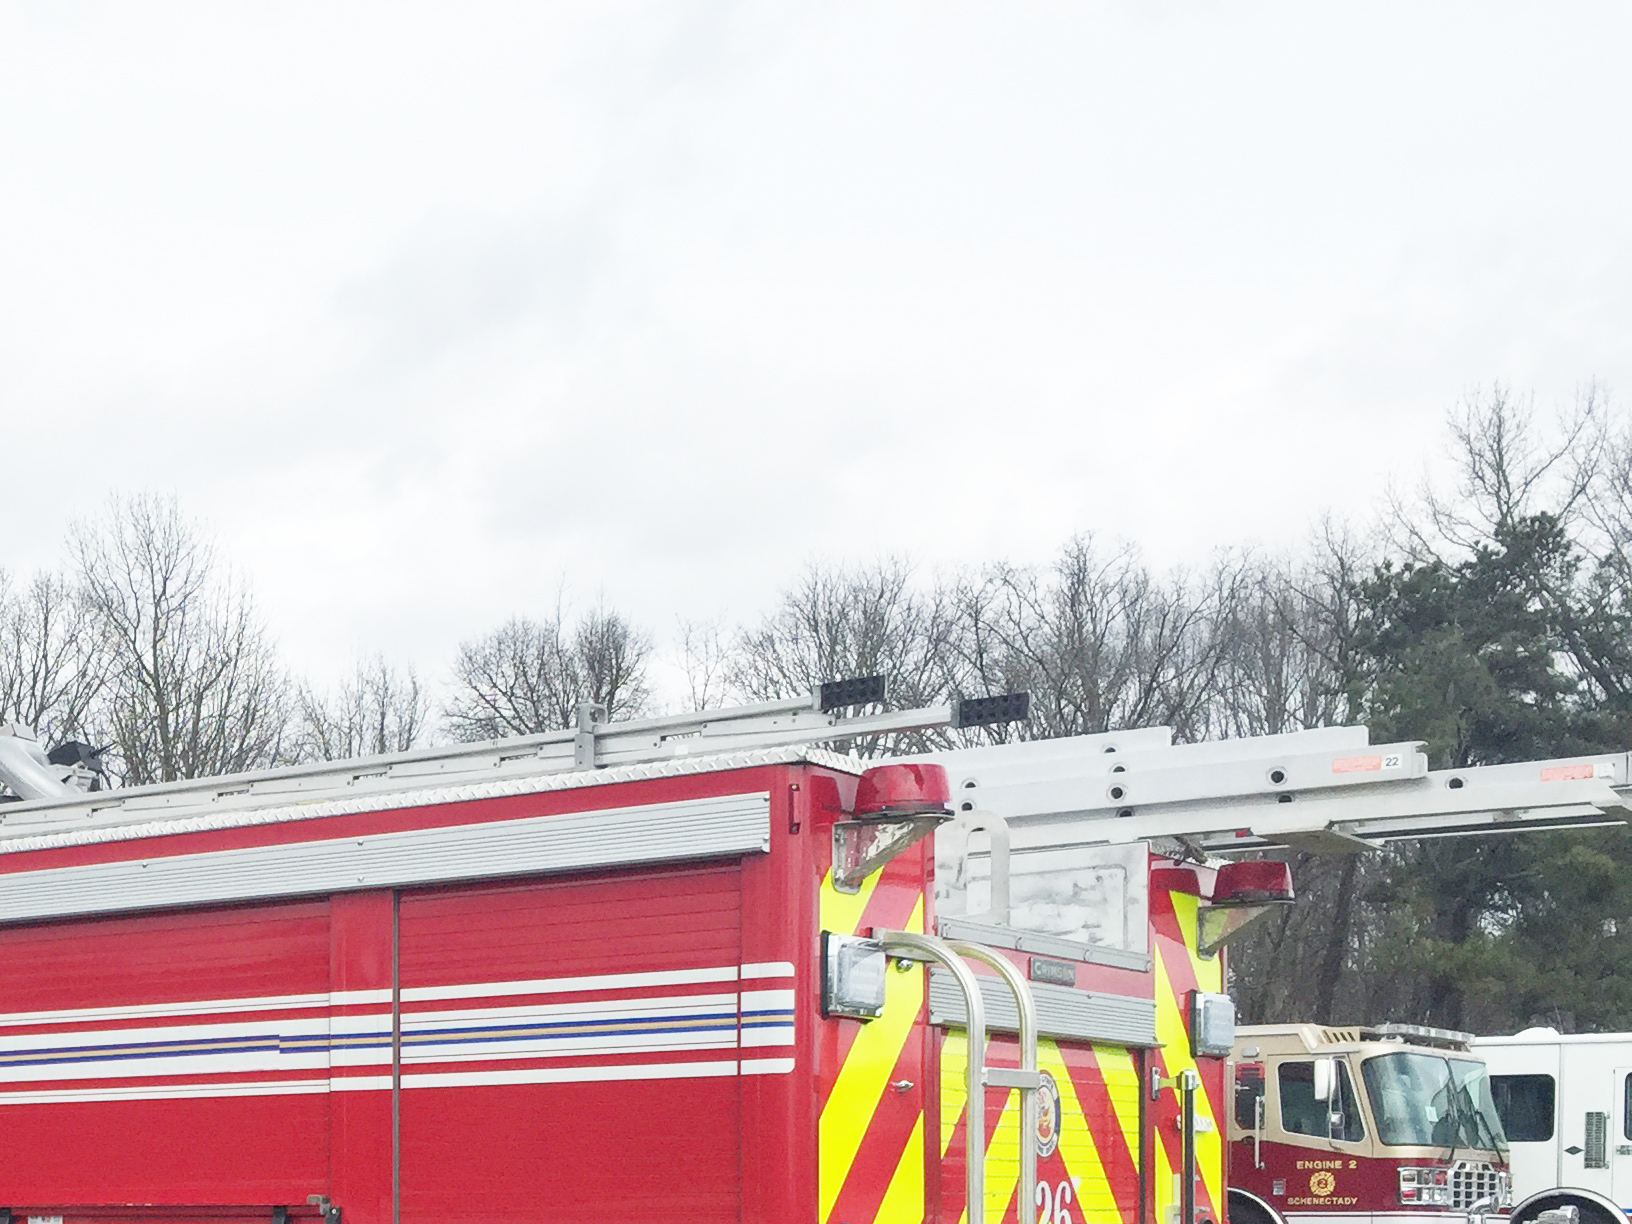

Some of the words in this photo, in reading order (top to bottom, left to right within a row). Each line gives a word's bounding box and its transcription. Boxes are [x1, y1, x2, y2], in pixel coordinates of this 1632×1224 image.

[1385, 756, 1399, 767] 22
[1296, 1160, 1343, 1170] ENGINE
[1348, 1160, 1358, 1169] 2
[1287, 1197, 1358, 1205] SCHENECTADY
